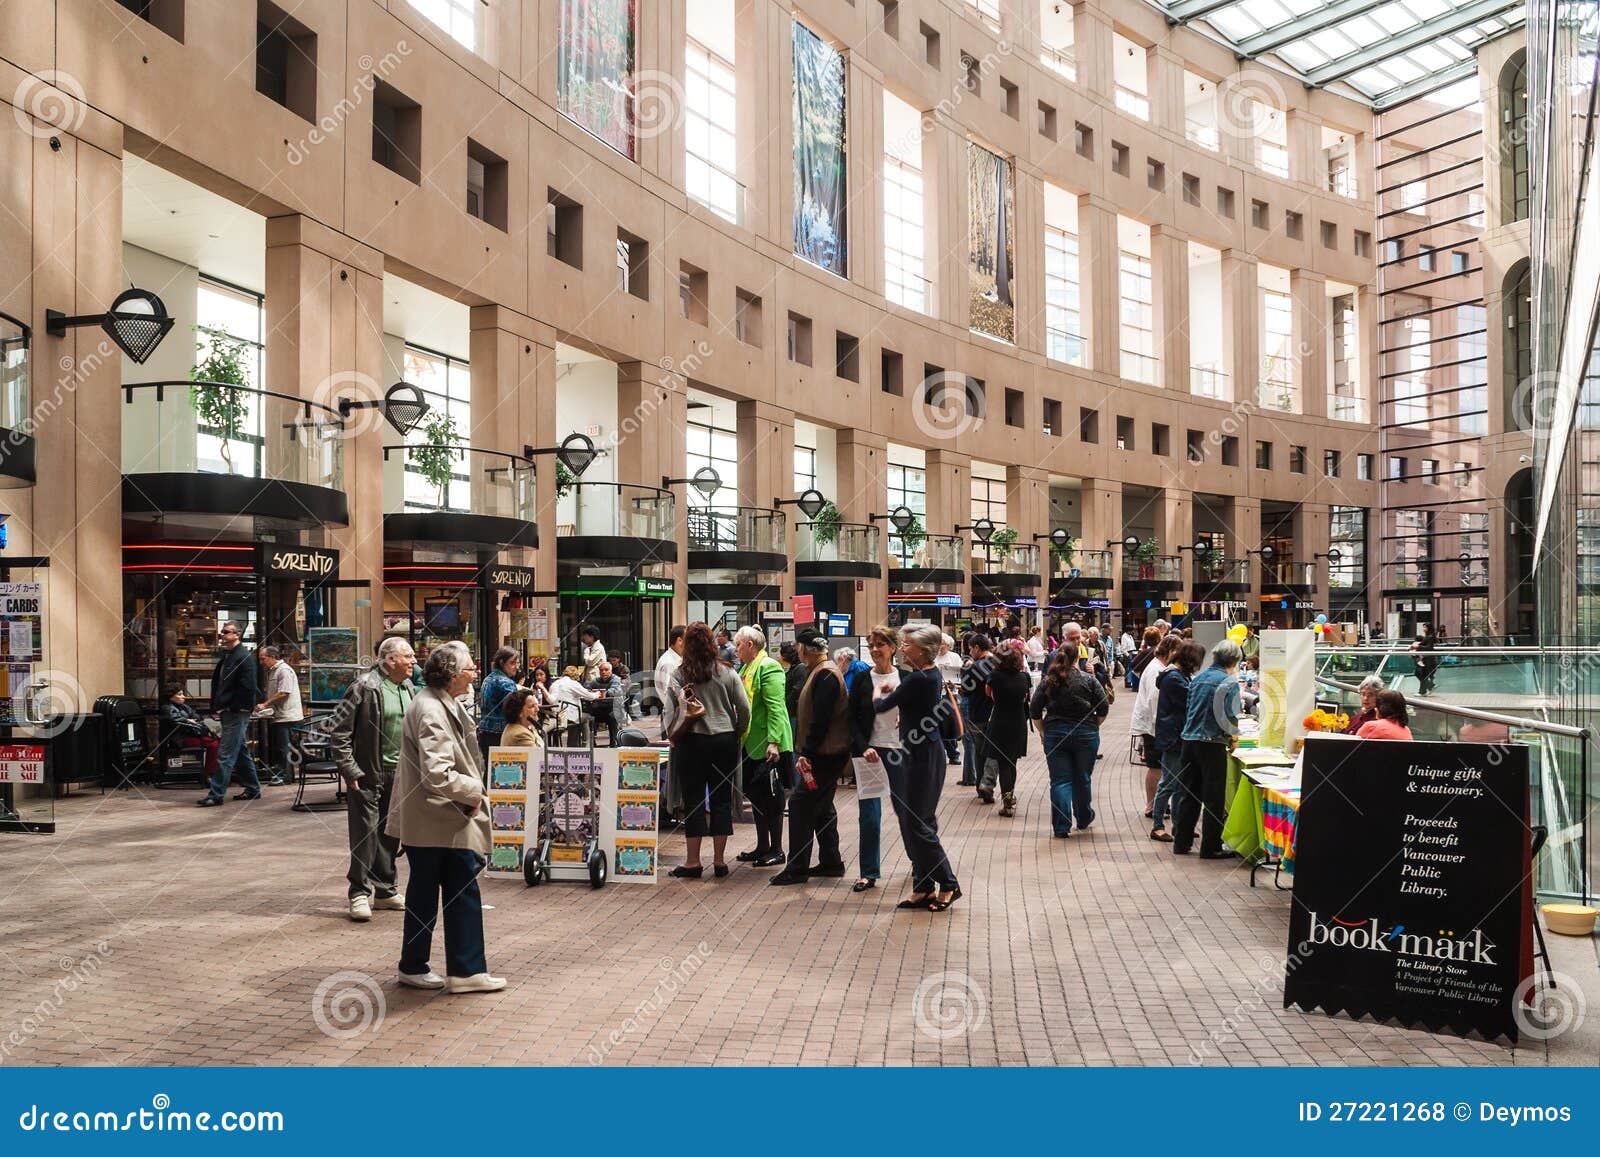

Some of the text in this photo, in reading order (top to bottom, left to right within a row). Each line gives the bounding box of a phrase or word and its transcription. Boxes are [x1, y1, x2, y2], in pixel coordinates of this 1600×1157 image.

[271, 552, 333, 575] SORENTO
[491, 569, 531, 588] SORENTO
[7, 599, 38, 612] CARDS
[1407, 765, 1482, 781] Unique gifts
[1406, 781, 1484, 799] & stationery.
[1404, 814, 1458, 828] Proceeds
[1402, 832, 1459, 847] to benefit
[1403, 847, 1466, 863] Vancouver
[1401, 864, 1441, 878] Public
[1400, 881, 1447, 899] Library.
[1396, 959, 1468, 975] The Library Store
[1403, 972, 1432, 984] Project
[1433, 975, 1444, 985] of
[1445, 977, 1476, 989] Friends
[1478, 981, 1489, 993] of
[1490, 983, 1502, 993] the
[1395, 982, 1499, 1006] Vancouver Public Library
